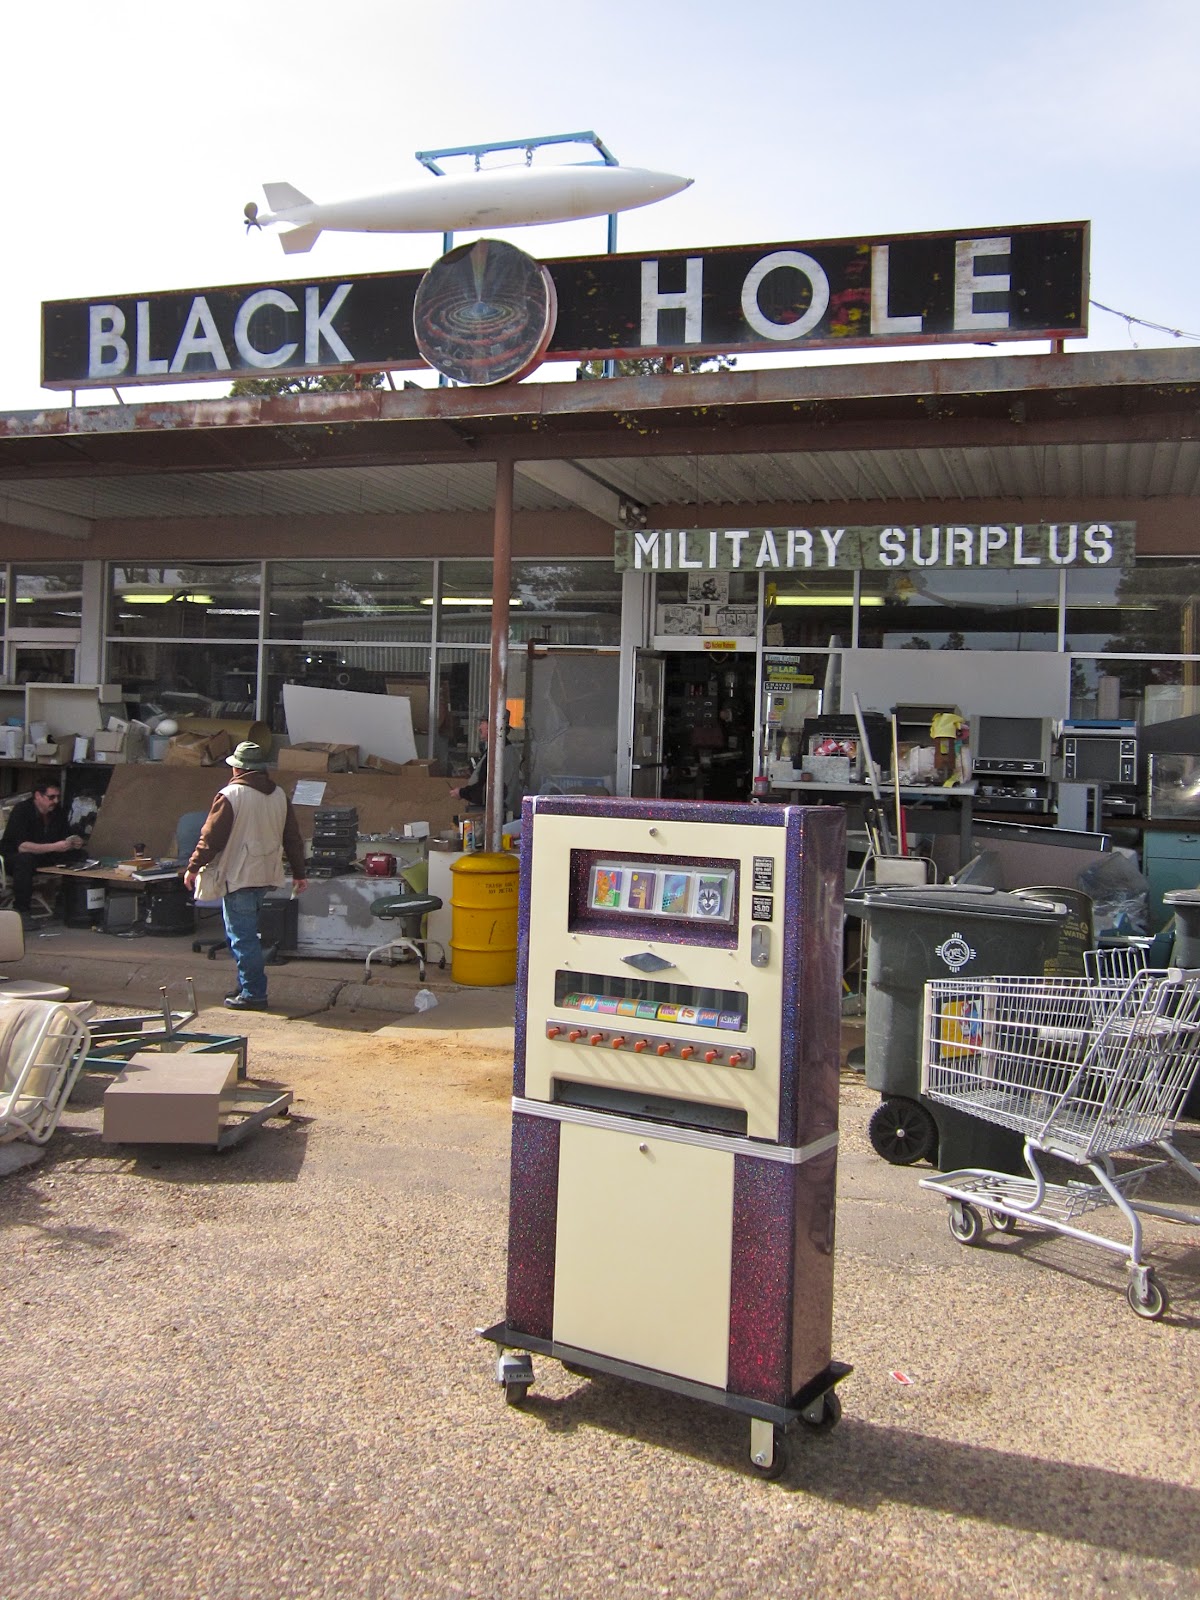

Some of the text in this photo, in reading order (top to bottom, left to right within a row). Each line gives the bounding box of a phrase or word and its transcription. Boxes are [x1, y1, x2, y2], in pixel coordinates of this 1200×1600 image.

[88, 236, 1012, 378] BLACK HOLE
[633, 524, 1114, 569] MILITARY SURPLUS
[1063, 929, 1087, 941] WATER
[681, 1007, 695, 1018] is
